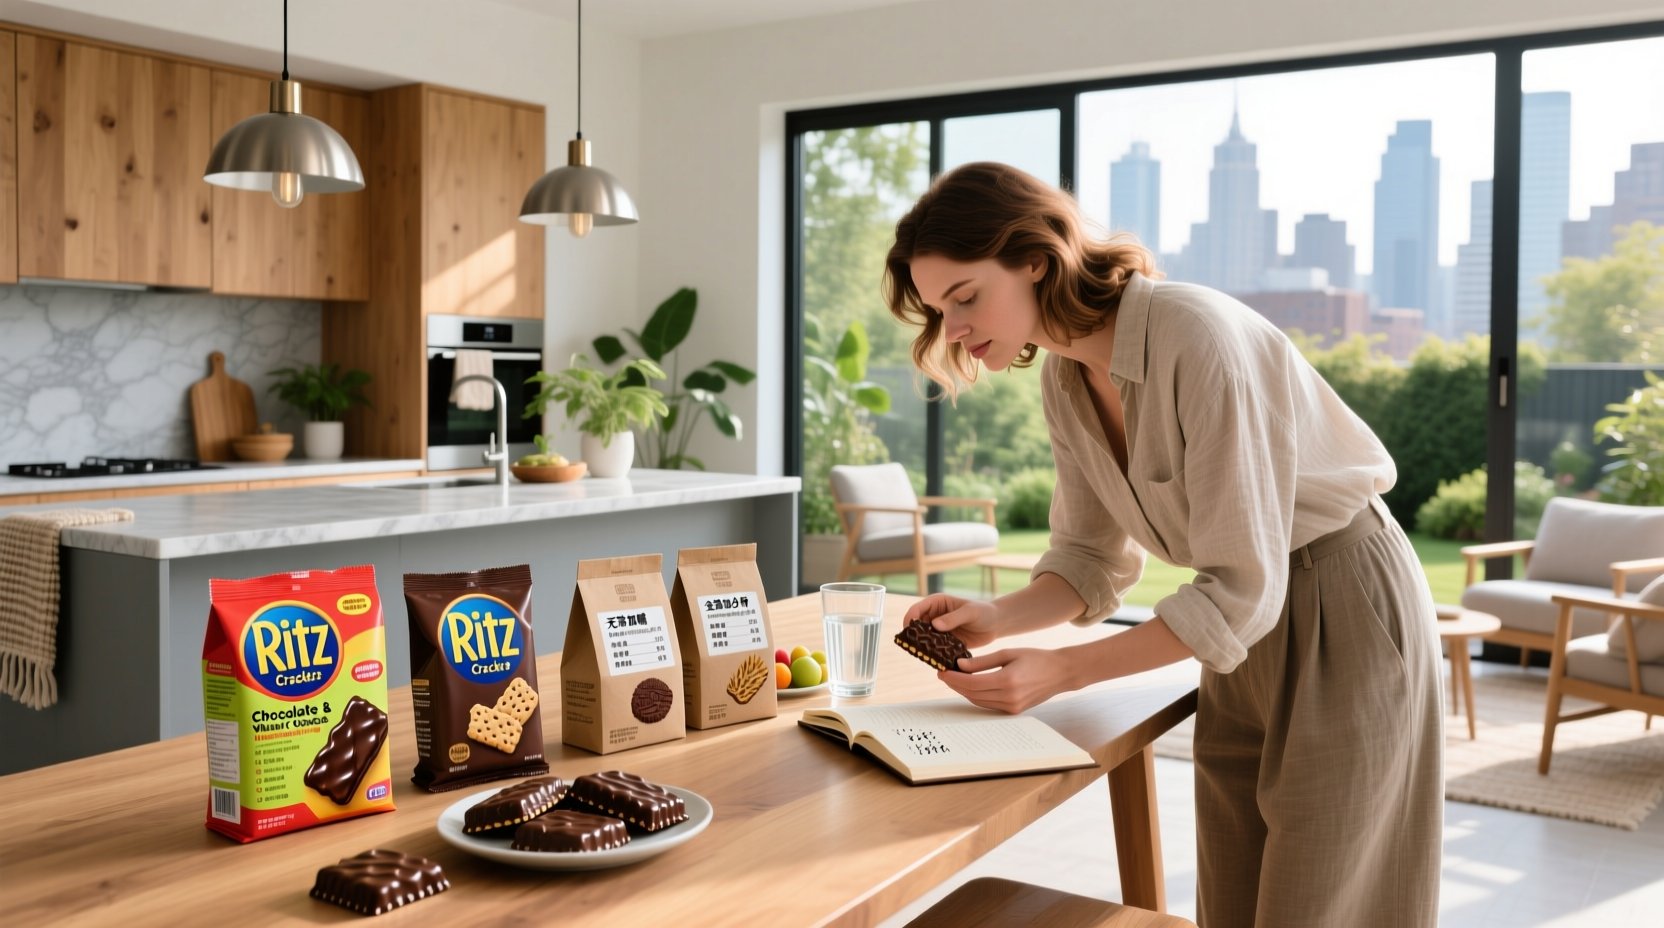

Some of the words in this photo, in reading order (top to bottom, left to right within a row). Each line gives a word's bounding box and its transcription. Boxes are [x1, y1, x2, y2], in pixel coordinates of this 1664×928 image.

[252, 619, 333, 675] Ritz
[447, 611, 520, 663] Ritz
[252, 705, 318, 723] Chocolate
